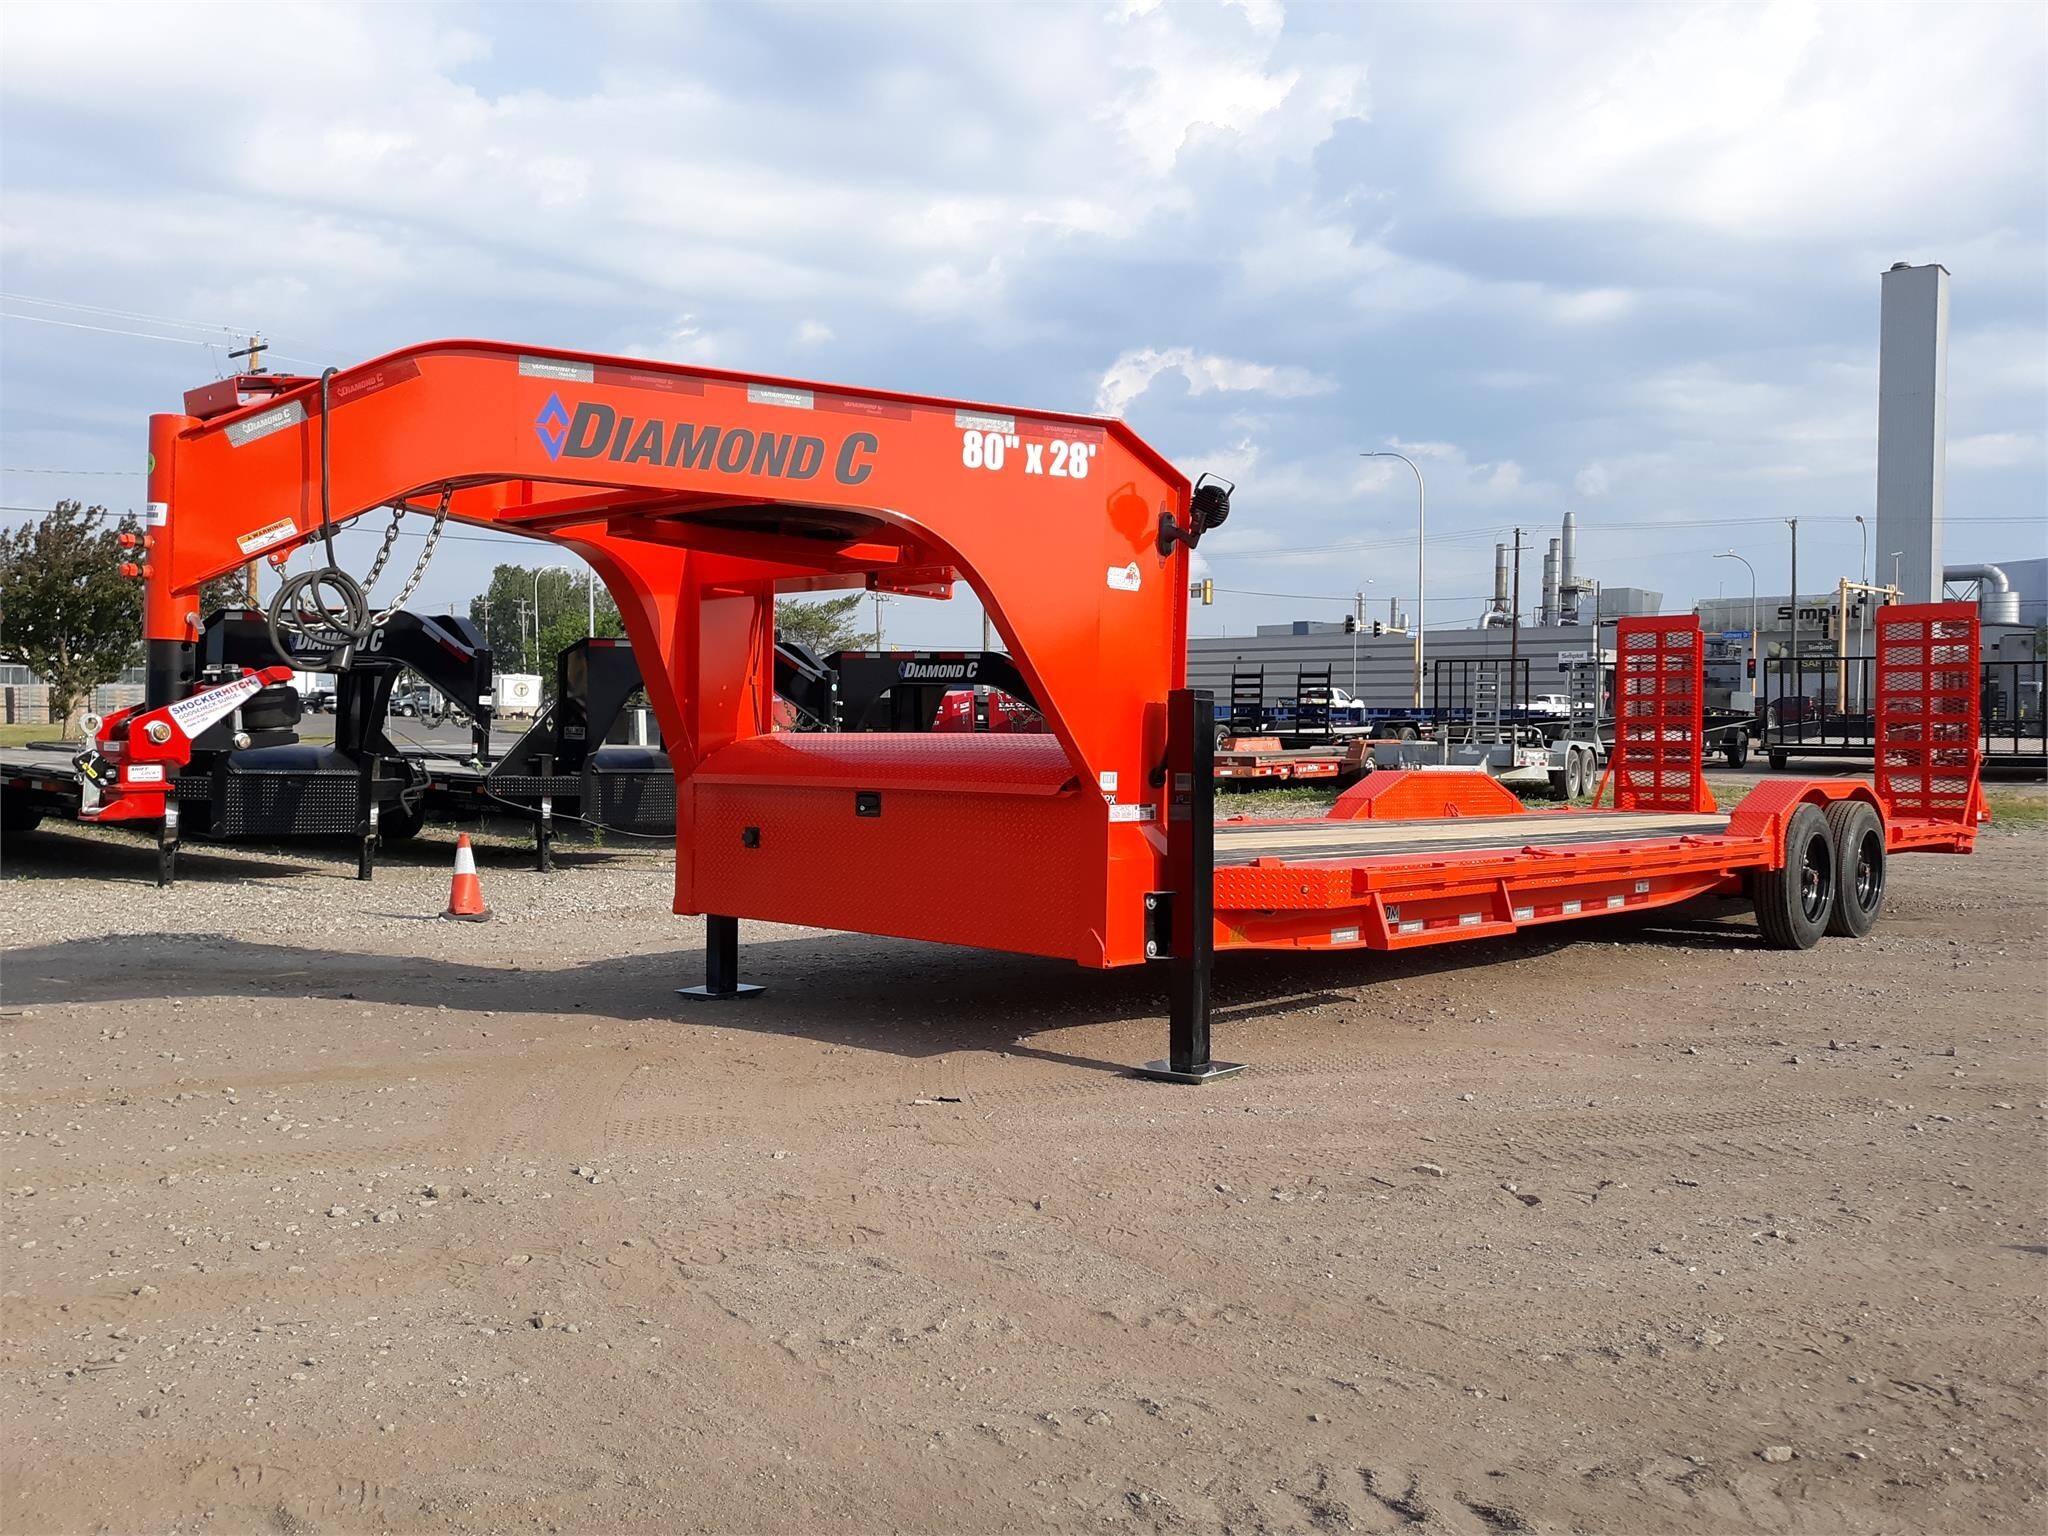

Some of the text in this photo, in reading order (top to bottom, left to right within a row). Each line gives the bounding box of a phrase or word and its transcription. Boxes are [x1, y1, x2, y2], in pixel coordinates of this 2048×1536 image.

[562, 400, 880, 486] DIAMOND C
[962, 430, 1020, 471] 80"
[1048, 440, 1097, 480] 28'
[251, 522, 285, 538] WARNING
[1778, 605, 1860, 624] Smplt
[369, 628, 385, 652] C
[904, 661, 979, 679] DIAMOND C
